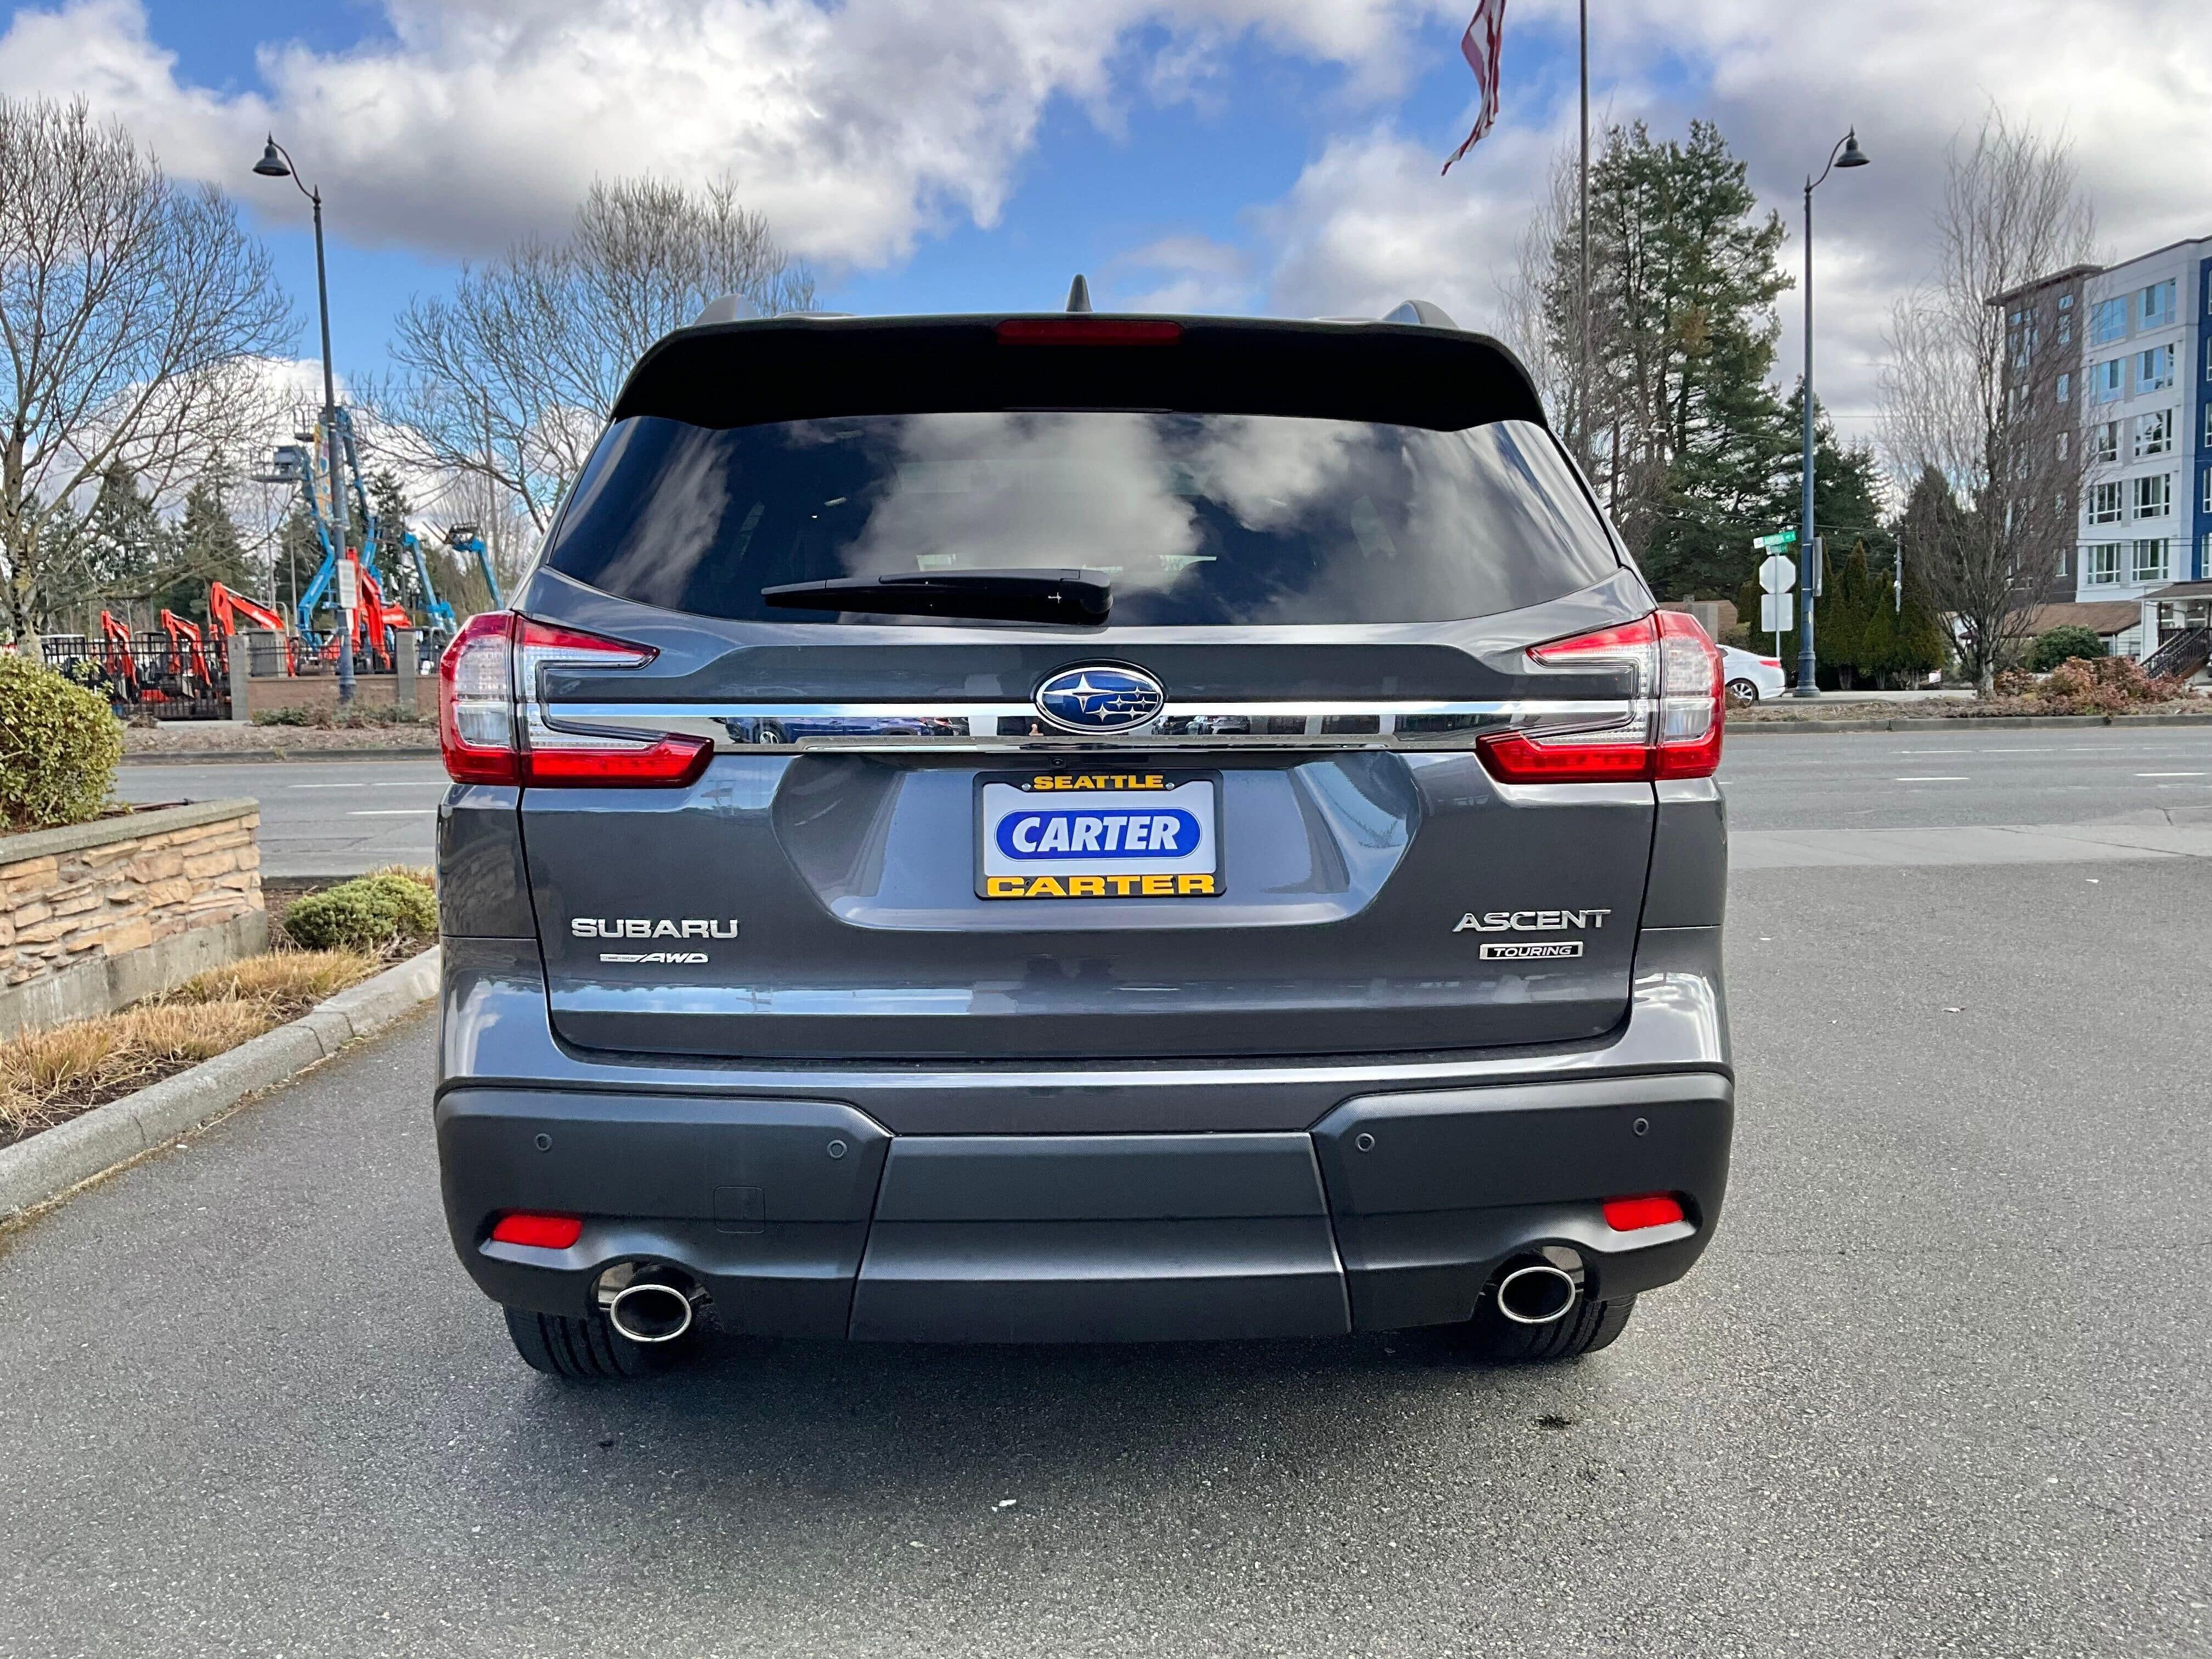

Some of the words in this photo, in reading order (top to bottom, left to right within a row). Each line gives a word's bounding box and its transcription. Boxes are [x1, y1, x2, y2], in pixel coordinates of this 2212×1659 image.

[1034, 775, 1164, 790] SEATTLE
[1012, 816, 1181, 853] CARTER
[987, 874, 1215, 897] CARTER
[571, 917, 738, 939] SUBARU
[1452, 909, 1612, 932] ASCENT
[639, 952, 709, 964] AWD
[1494, 946, 1573, 957] TOURING
